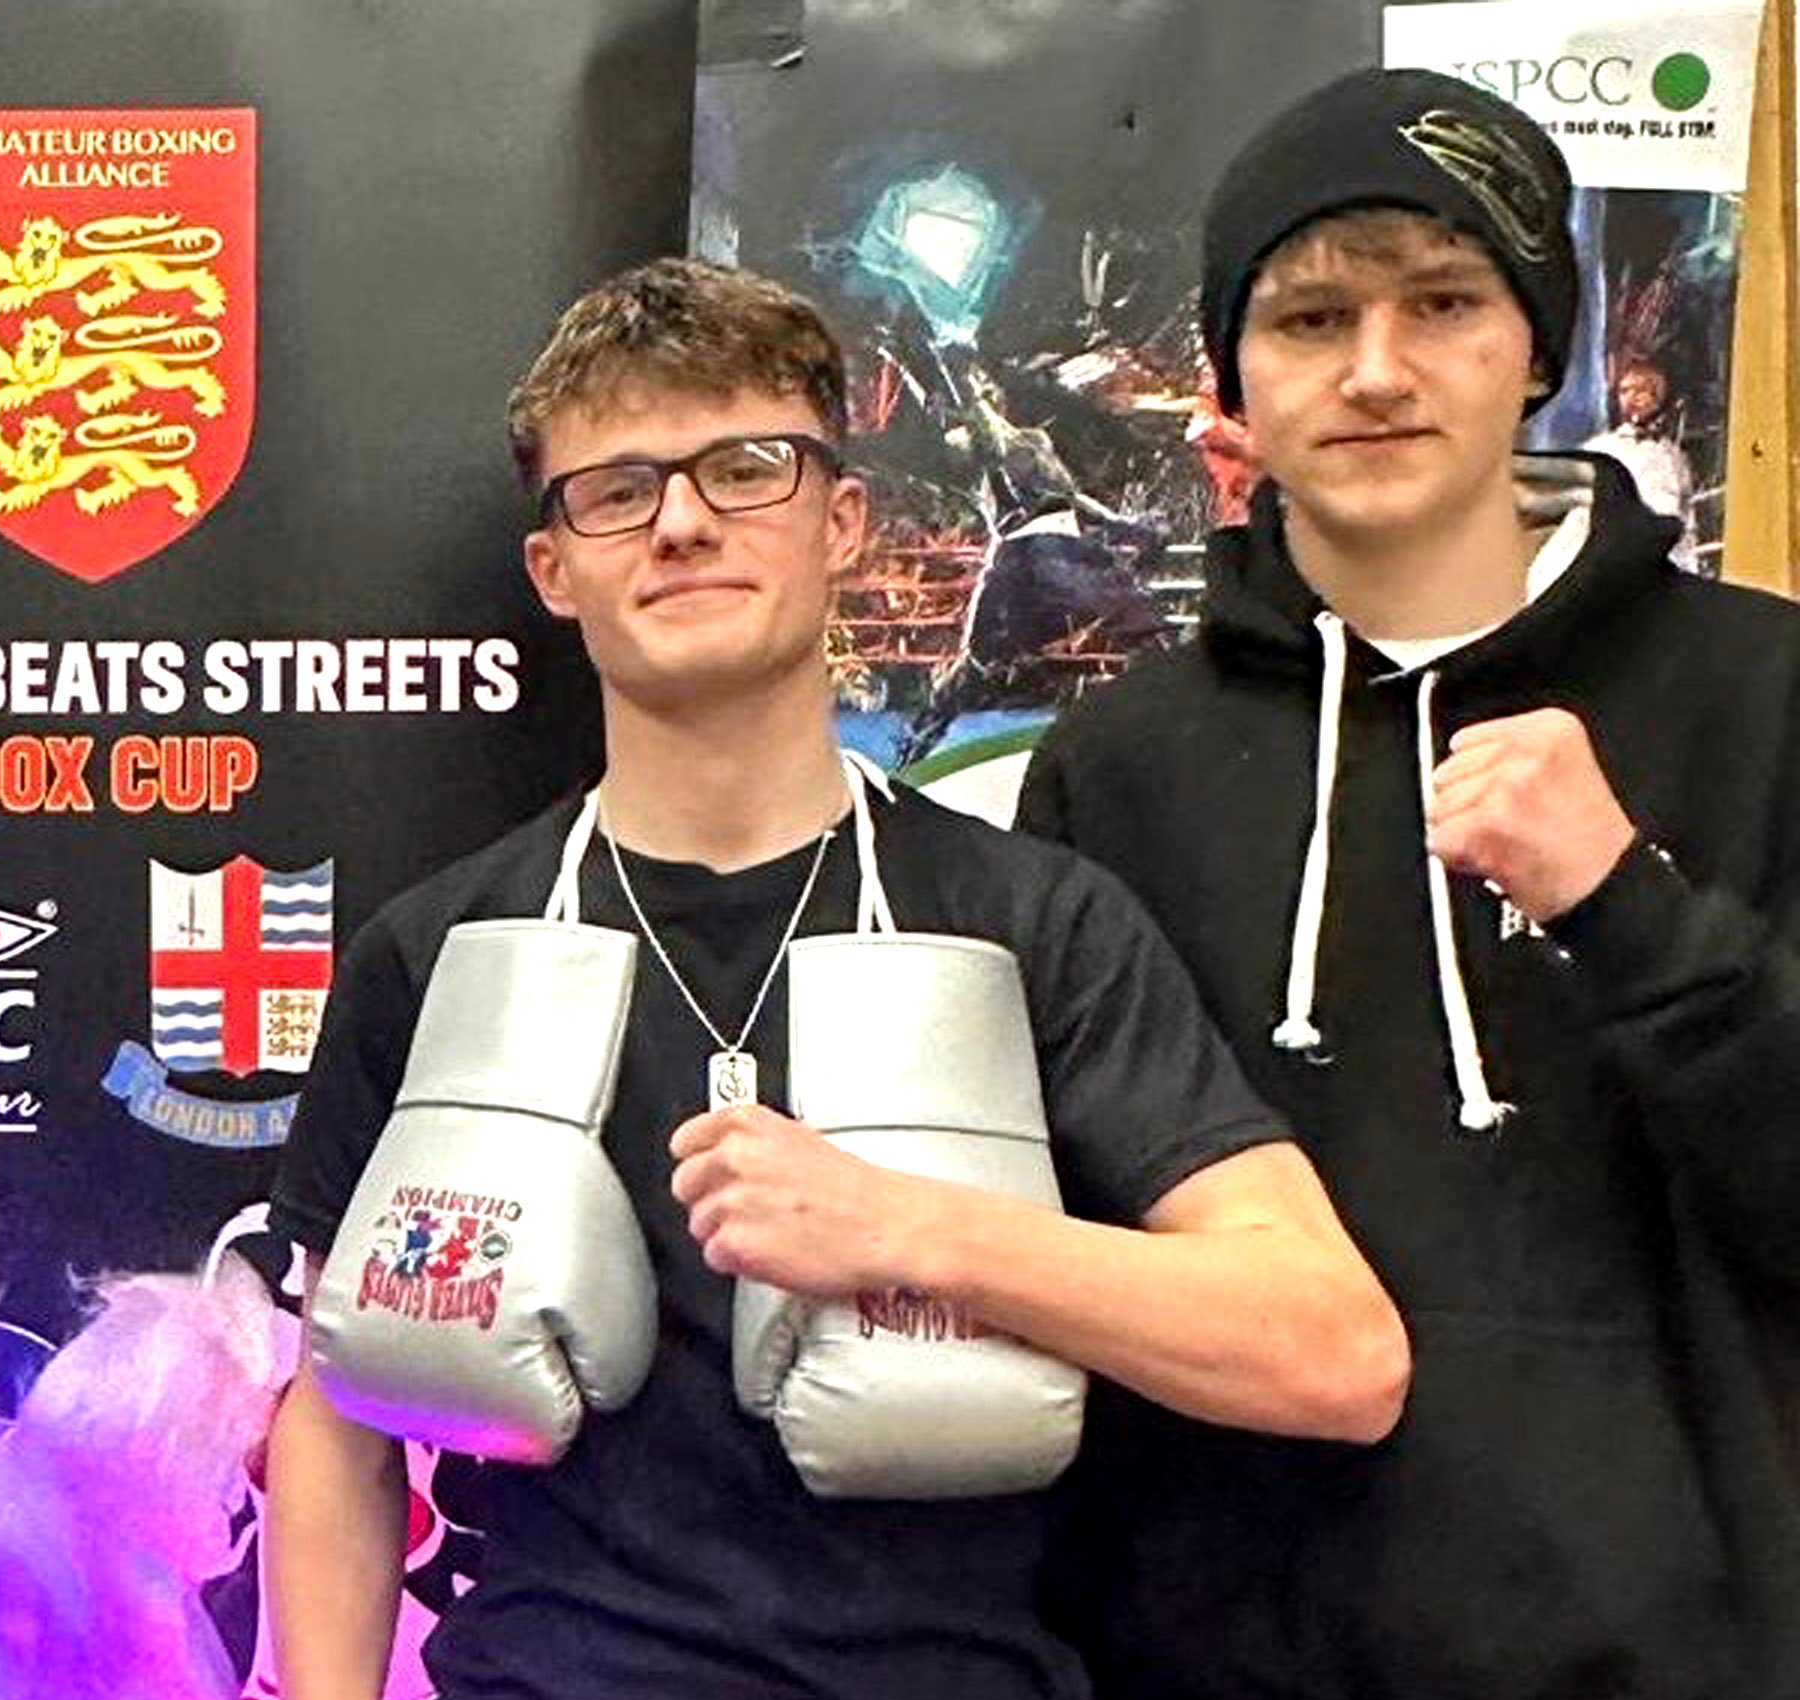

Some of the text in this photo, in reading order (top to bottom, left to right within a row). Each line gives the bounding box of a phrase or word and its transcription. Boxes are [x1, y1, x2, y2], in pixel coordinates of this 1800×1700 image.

[1452, 55, 1633, 105] SPCC
[112, 127, 236, 154] BOXING
[19, 162, 169, 187] ALLIANCE
[203, 638, 521, 713] STREETS
[111, 735, 259, 813] CUP
[391, 1185, 522, 1222] CHAMPION
